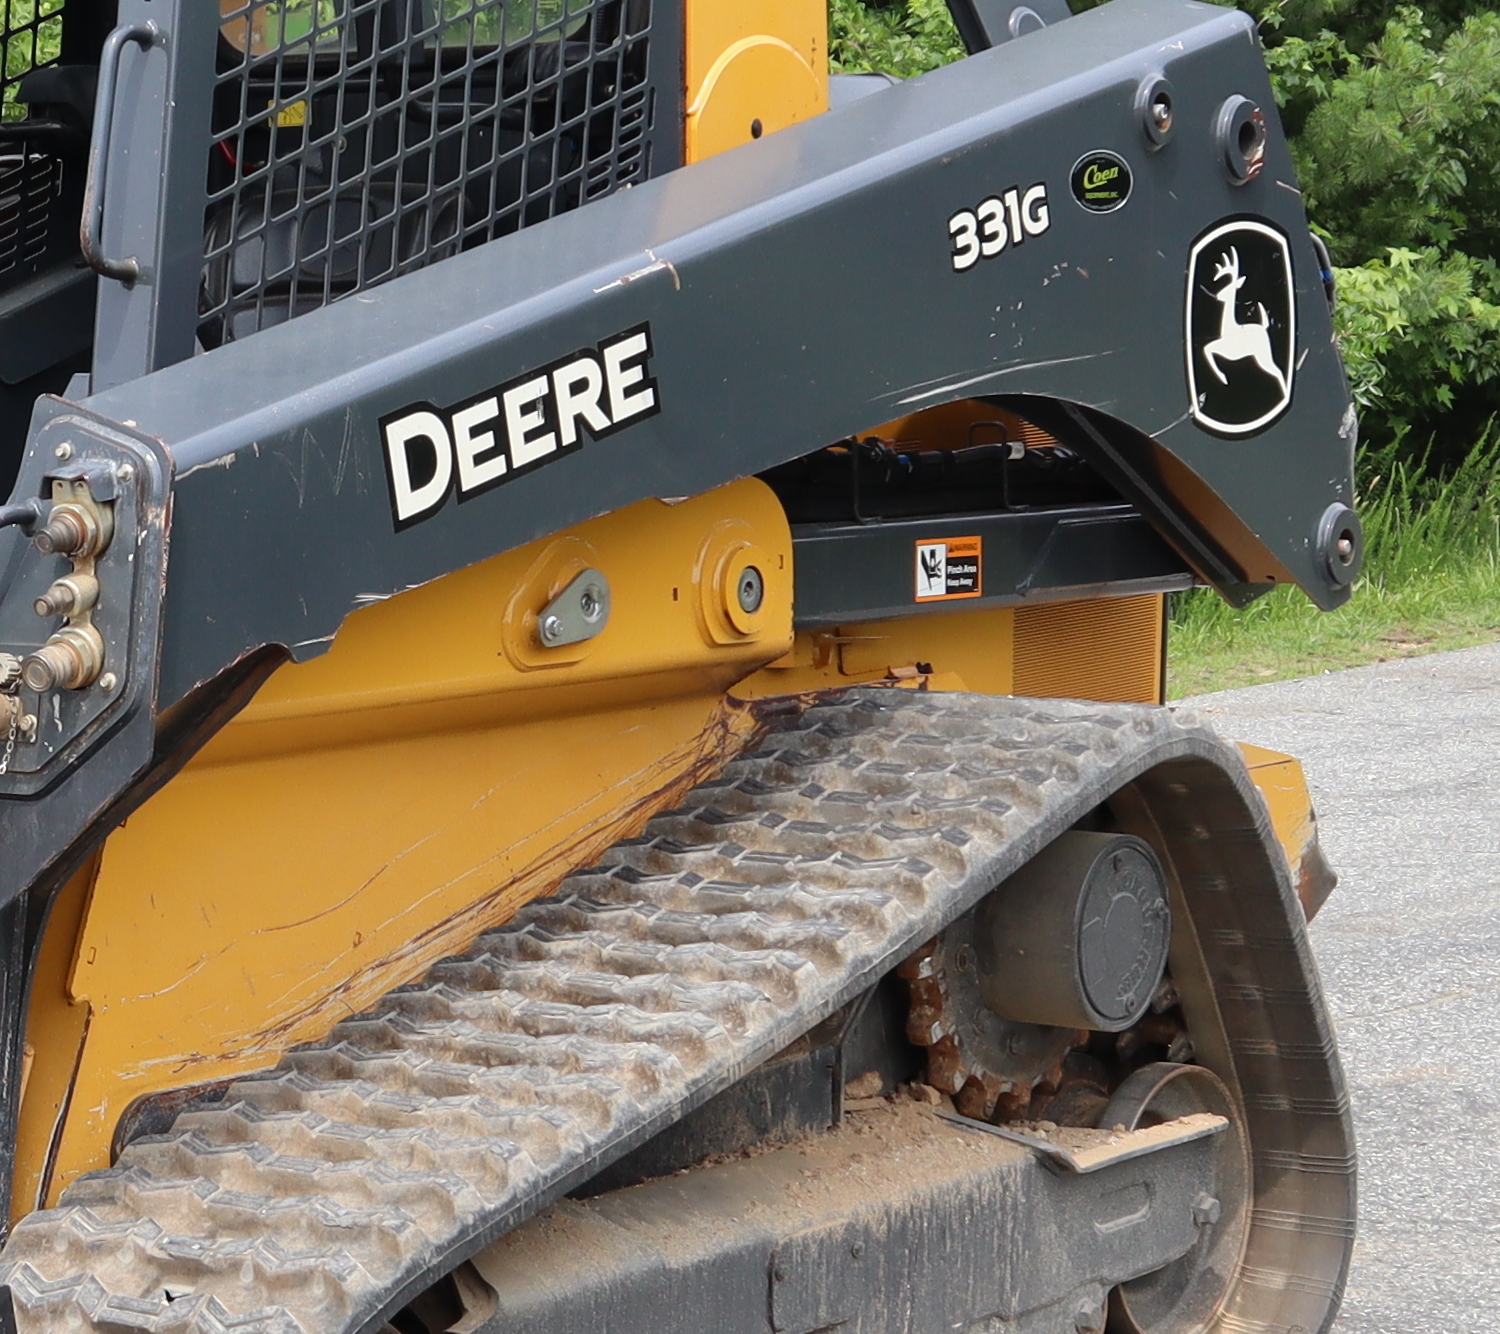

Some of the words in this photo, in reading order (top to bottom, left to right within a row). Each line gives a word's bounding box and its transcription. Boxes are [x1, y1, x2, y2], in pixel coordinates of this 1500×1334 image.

[1083, 164, 1119, 190] Coen
[949, 185, 1050, 270] 331G
[385, 332, 655, 521] DEERE
[947, 565, 963, 575] Pinch
[963, 564, 977, 573] Area
[947, 578, 960, 587] Keep
[960, 577, 974, 586] Away
